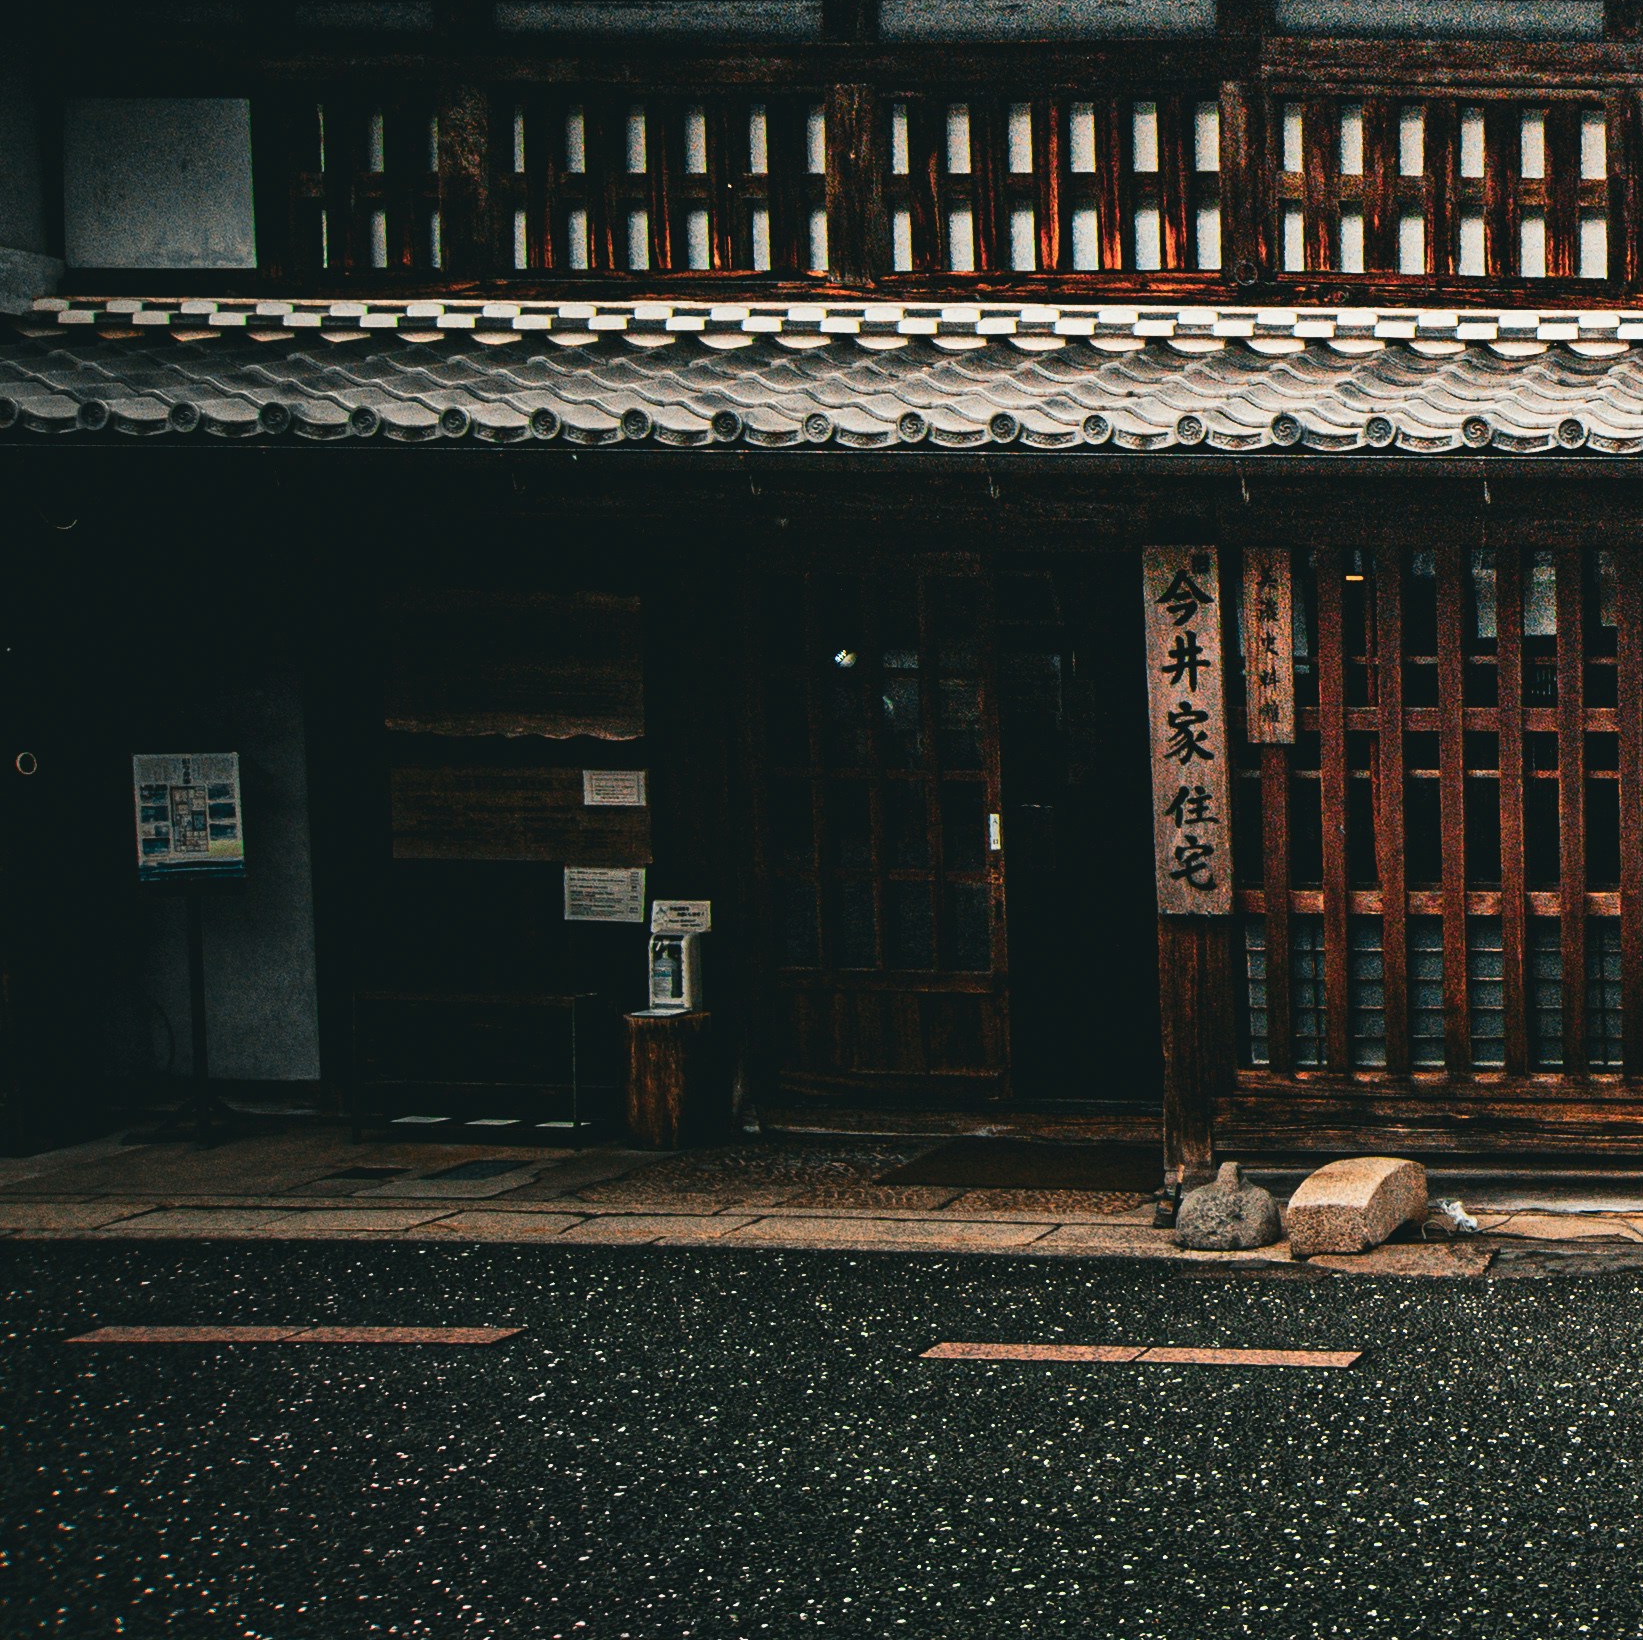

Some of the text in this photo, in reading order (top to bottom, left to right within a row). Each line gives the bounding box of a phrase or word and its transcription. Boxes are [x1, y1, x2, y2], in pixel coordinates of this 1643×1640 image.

[1154, 568, 1220, 892] 今井家住宅
